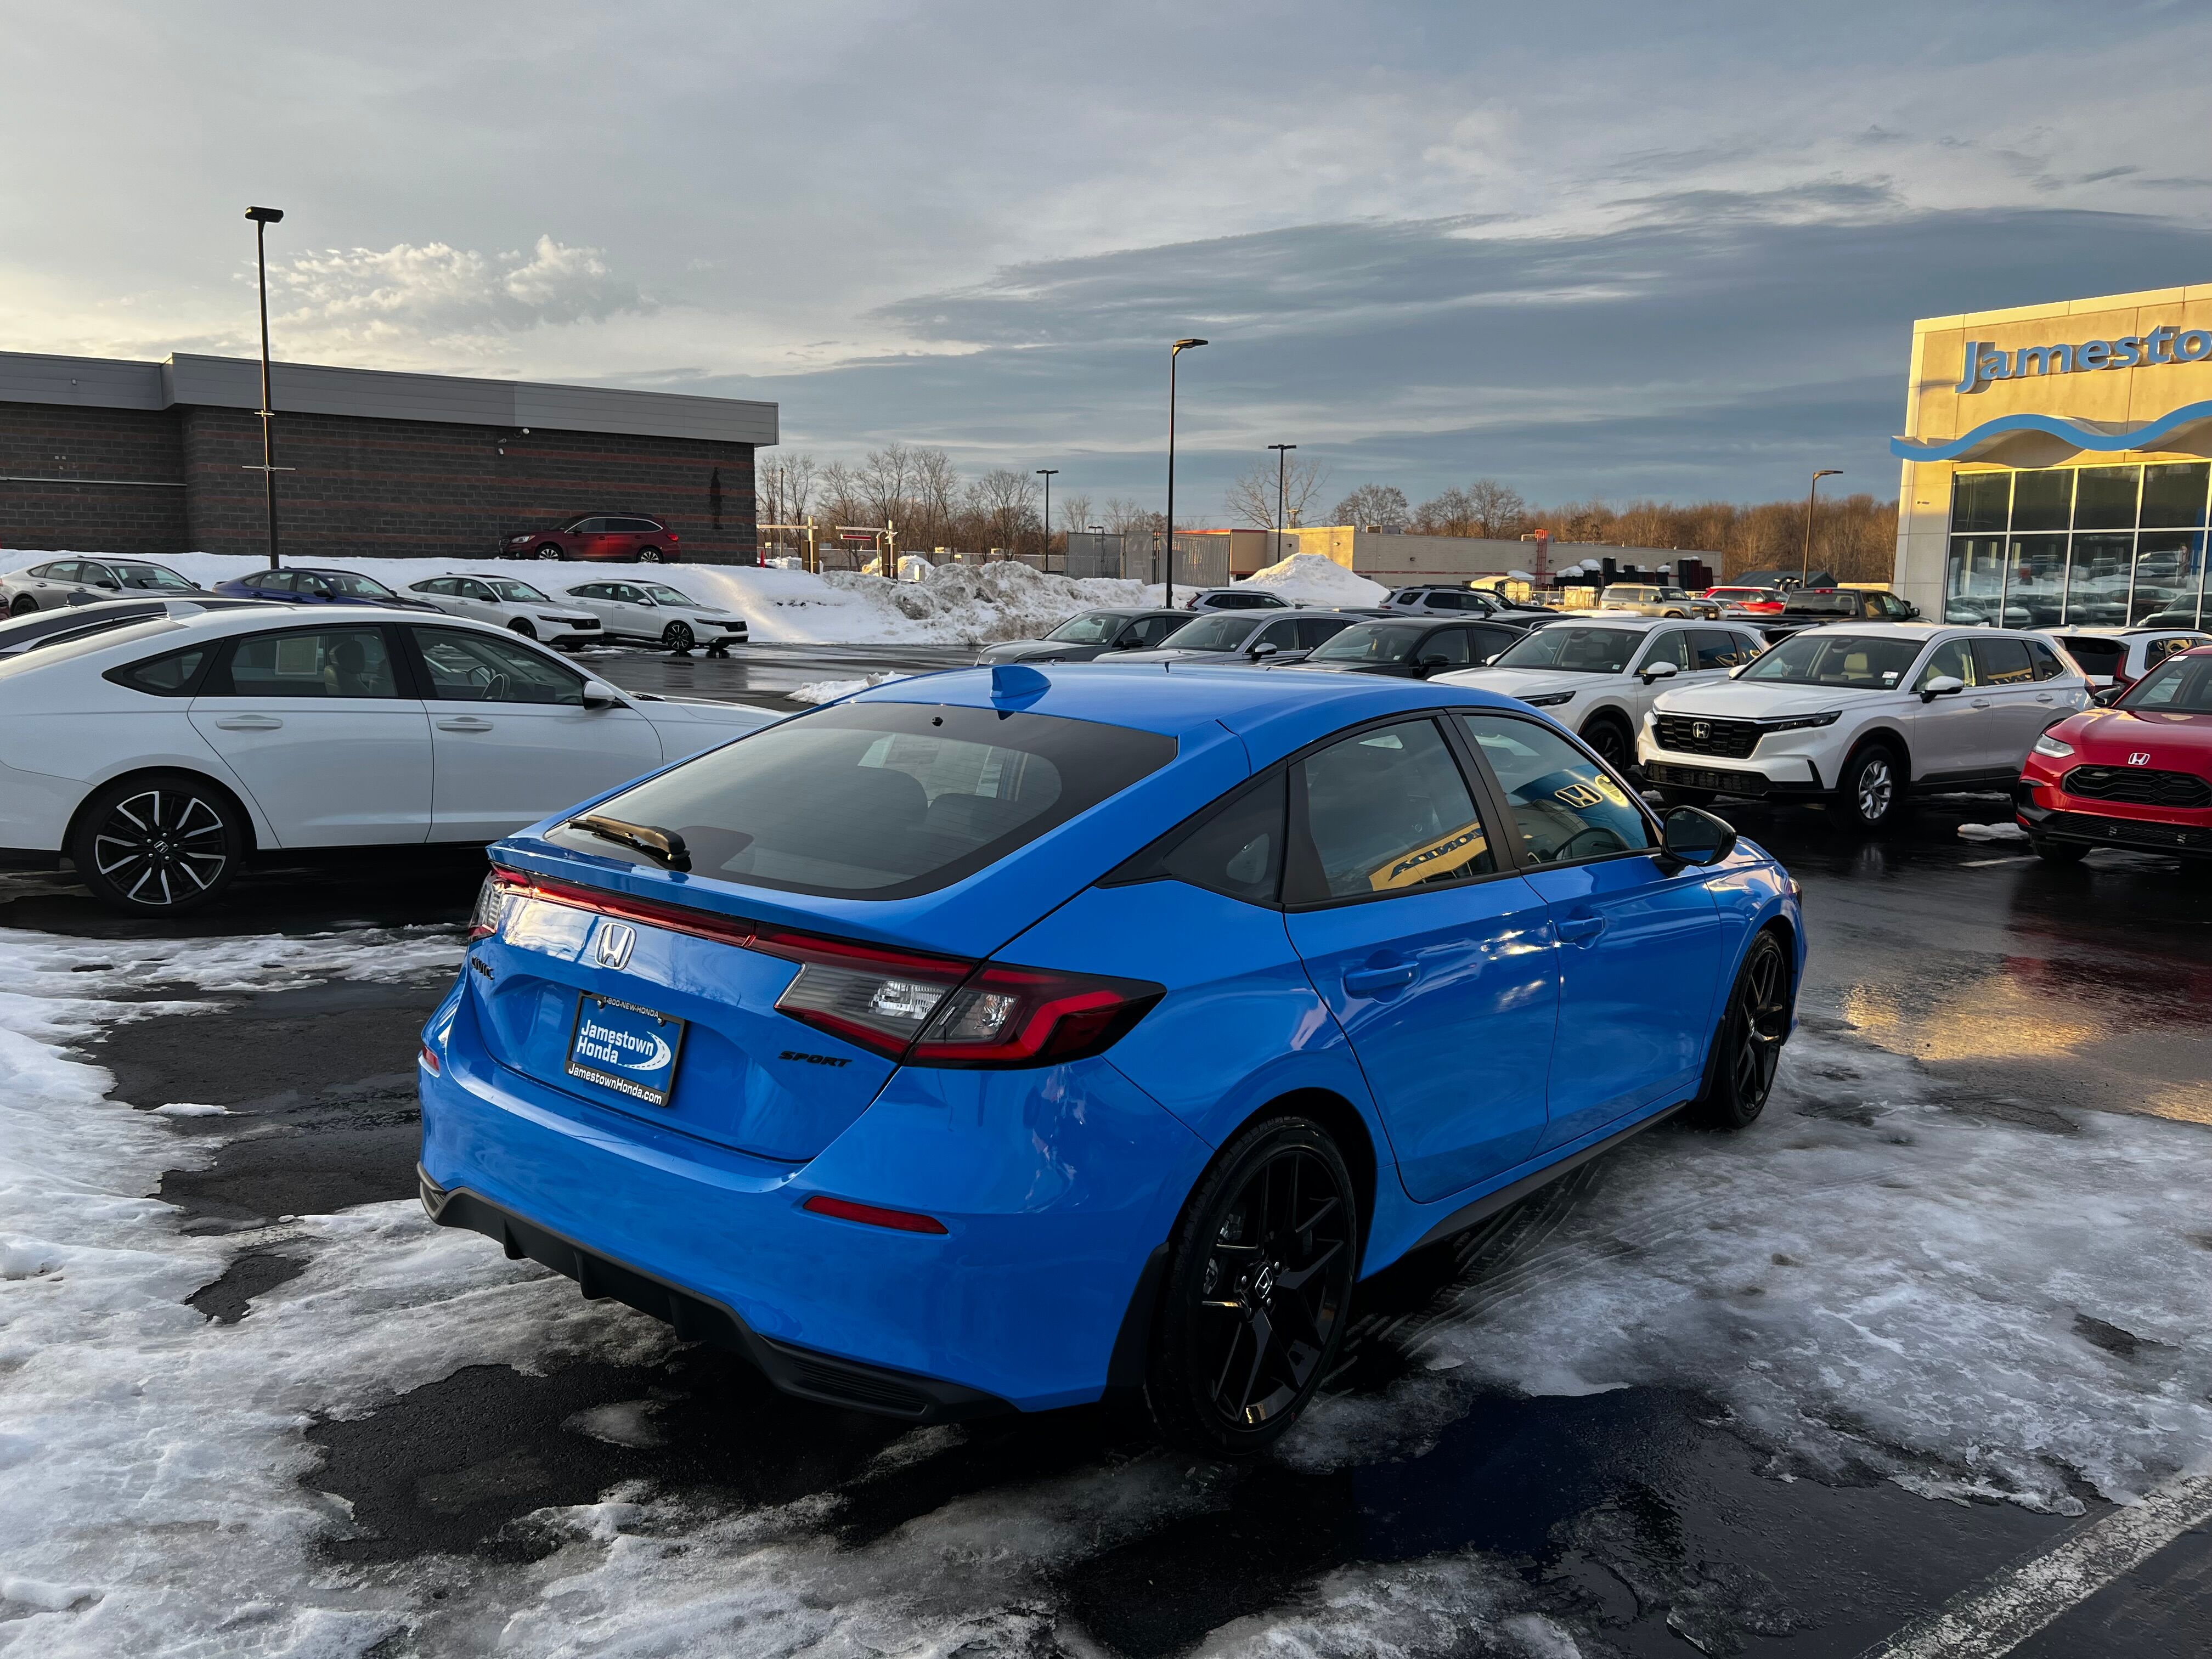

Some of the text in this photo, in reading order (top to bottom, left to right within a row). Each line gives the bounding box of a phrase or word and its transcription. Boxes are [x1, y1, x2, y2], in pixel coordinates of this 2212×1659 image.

[1955, 325, 2212, 393] Jamesto
[471, 956, 495, 980] CIVIC
[603, 996, 659, 1018] 1-800-NEW-HONDA
[576, 1036, 619, 1064] Honda
[580, 1019, 654, 1057] Jamestown
[778, 1051, 853, 1068] SPORT
[568, 1063, 662, 1105] JamestownHonda.com
